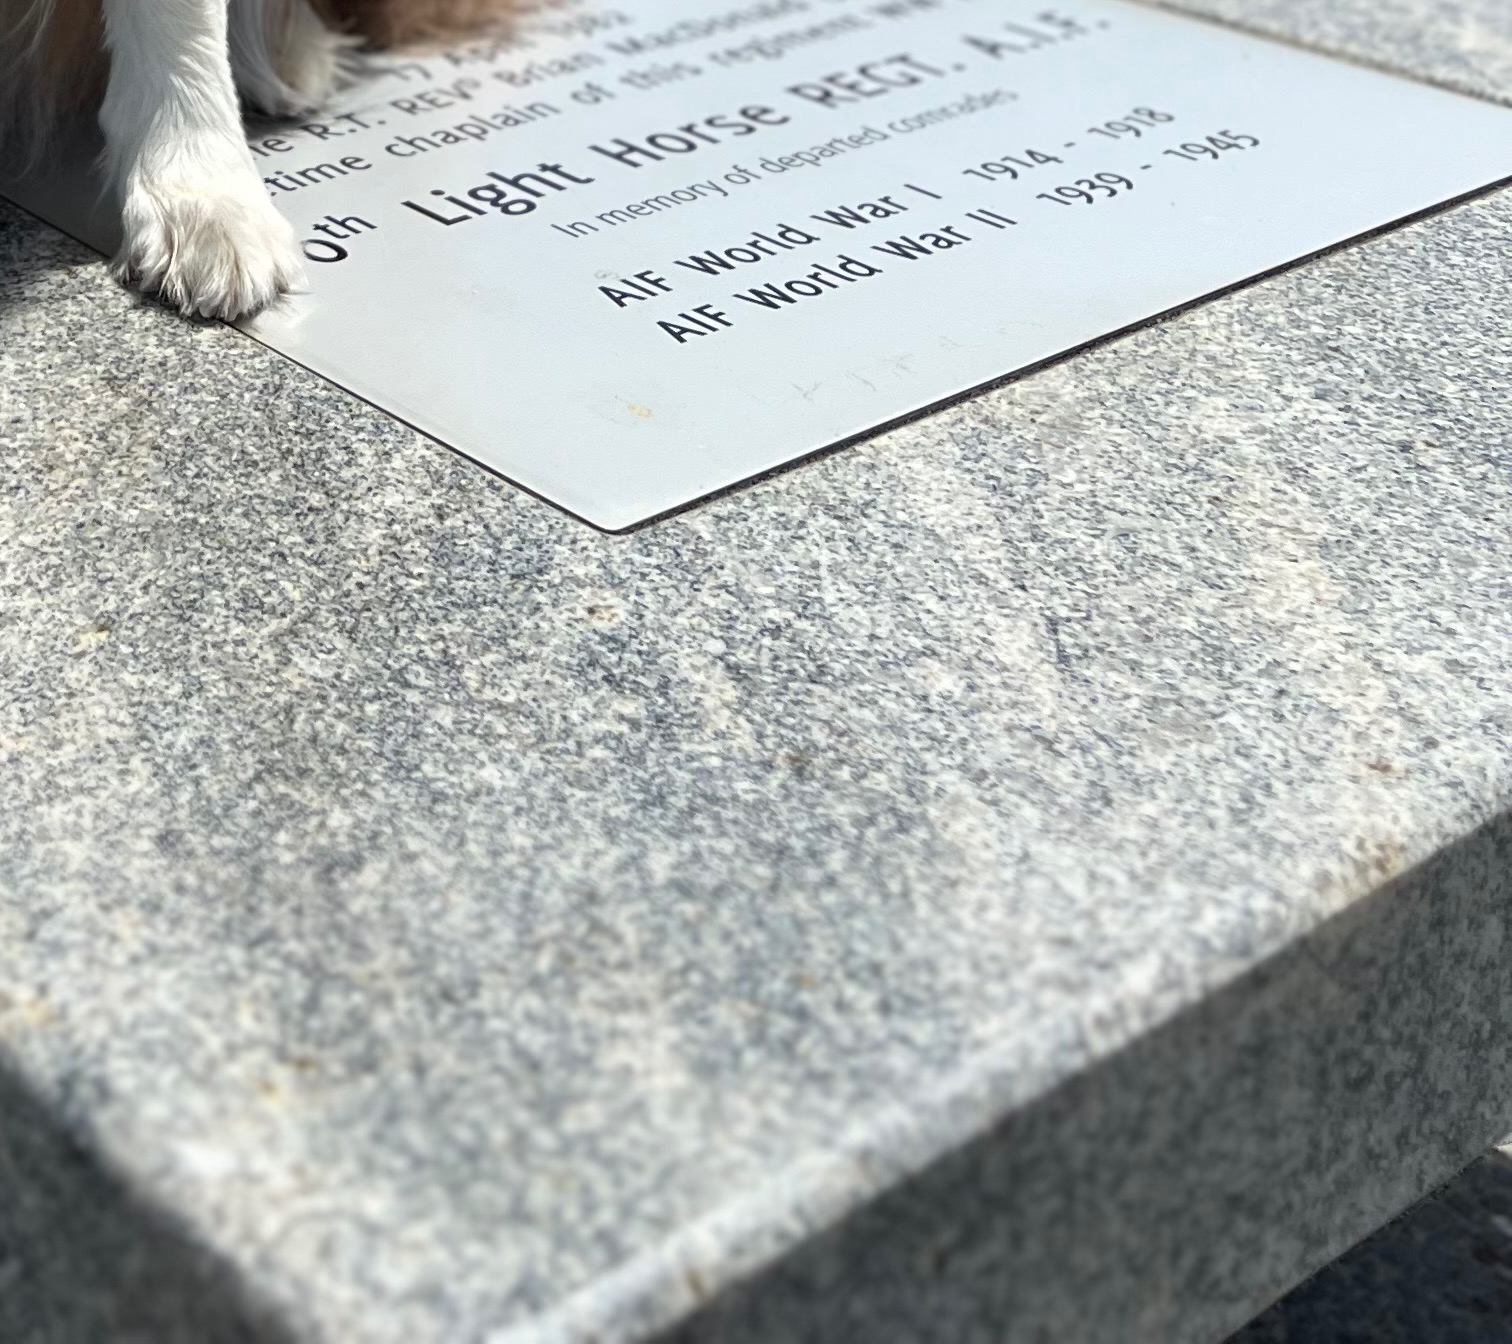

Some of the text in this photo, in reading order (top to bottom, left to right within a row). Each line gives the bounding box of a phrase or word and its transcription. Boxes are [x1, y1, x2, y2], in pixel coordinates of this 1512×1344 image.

[385, 101, 563, 157] chaplain
[570, 81, 616, 105] of
[619, 61, 702, 90] this
[400, 162, 595, 227] Light
[587, 104, 791, 169] Horse
[550, 89, 1019, 238] In memory of departed comrades
[597, 270, 673, 308] AIF
[672, 223, 821, 276] World
[809, 195, 909, 229] War
[903, 183, 942, 199] I
[962, 148, 1064, 181] 1914
[1086, 106, 1175, 139] 1918
[656, 304, 734, 344] AIF
[732, 254, 883, 310] World
[870, 225, 972, 261] War
[964, 208, 1018, 229] II
[1035, 172, 1134, 205] 1939
[1162, 129, 1260, 160] 1945
